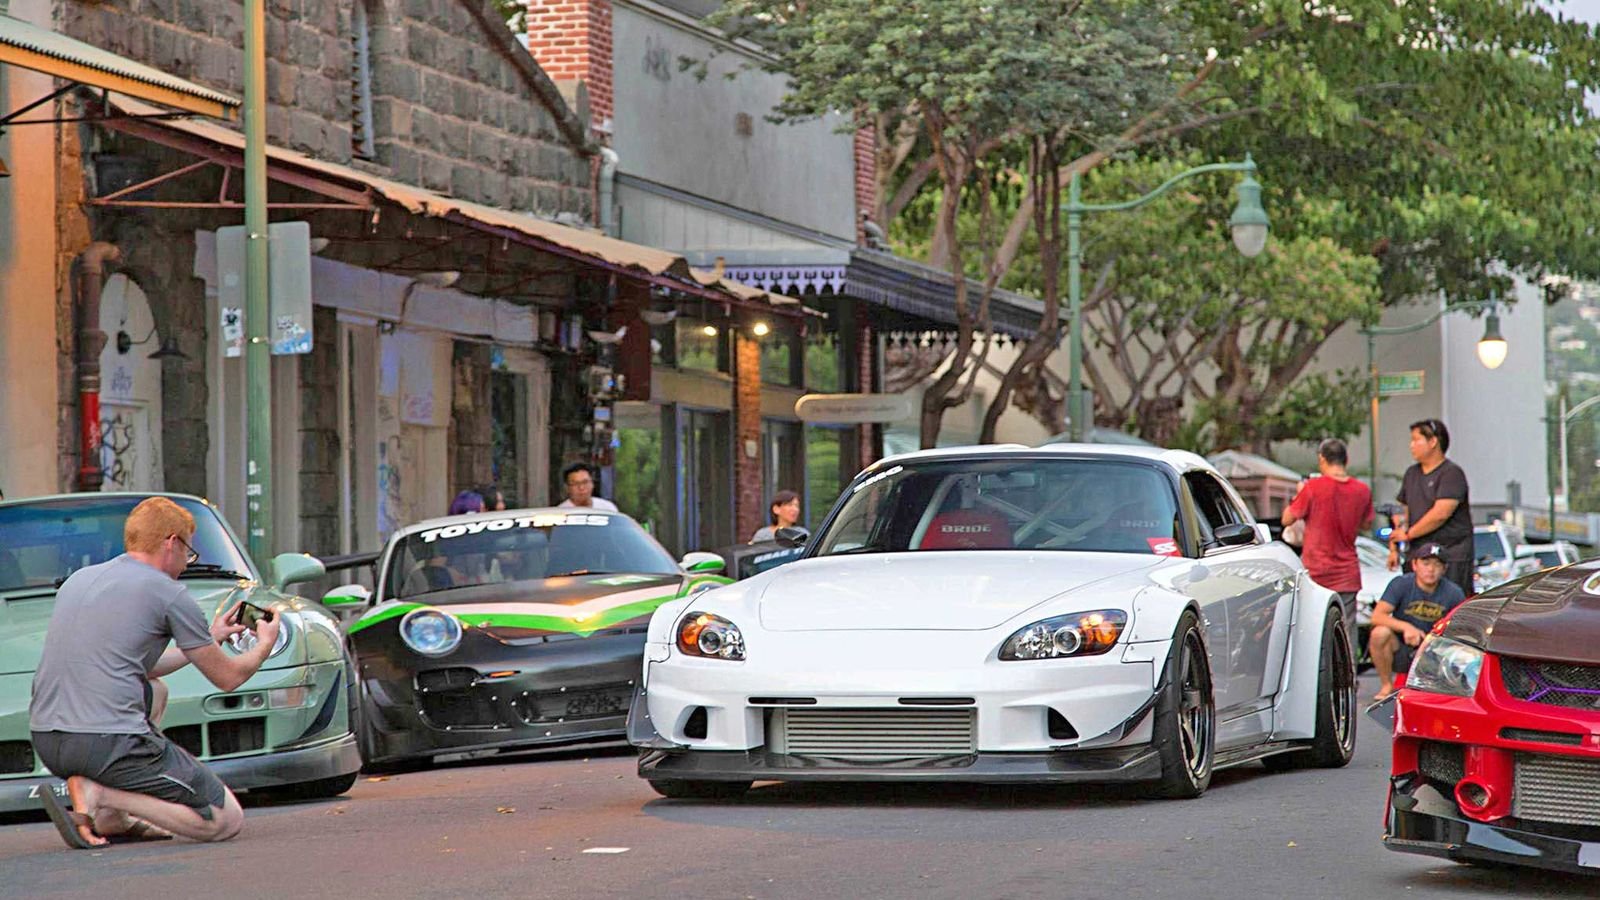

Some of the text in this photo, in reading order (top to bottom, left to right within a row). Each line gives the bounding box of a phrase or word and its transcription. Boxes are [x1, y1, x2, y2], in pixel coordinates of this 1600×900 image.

[420, 514, 609, 543] TOYO TIRES
[941, 524, 992, 533] BRIDE
